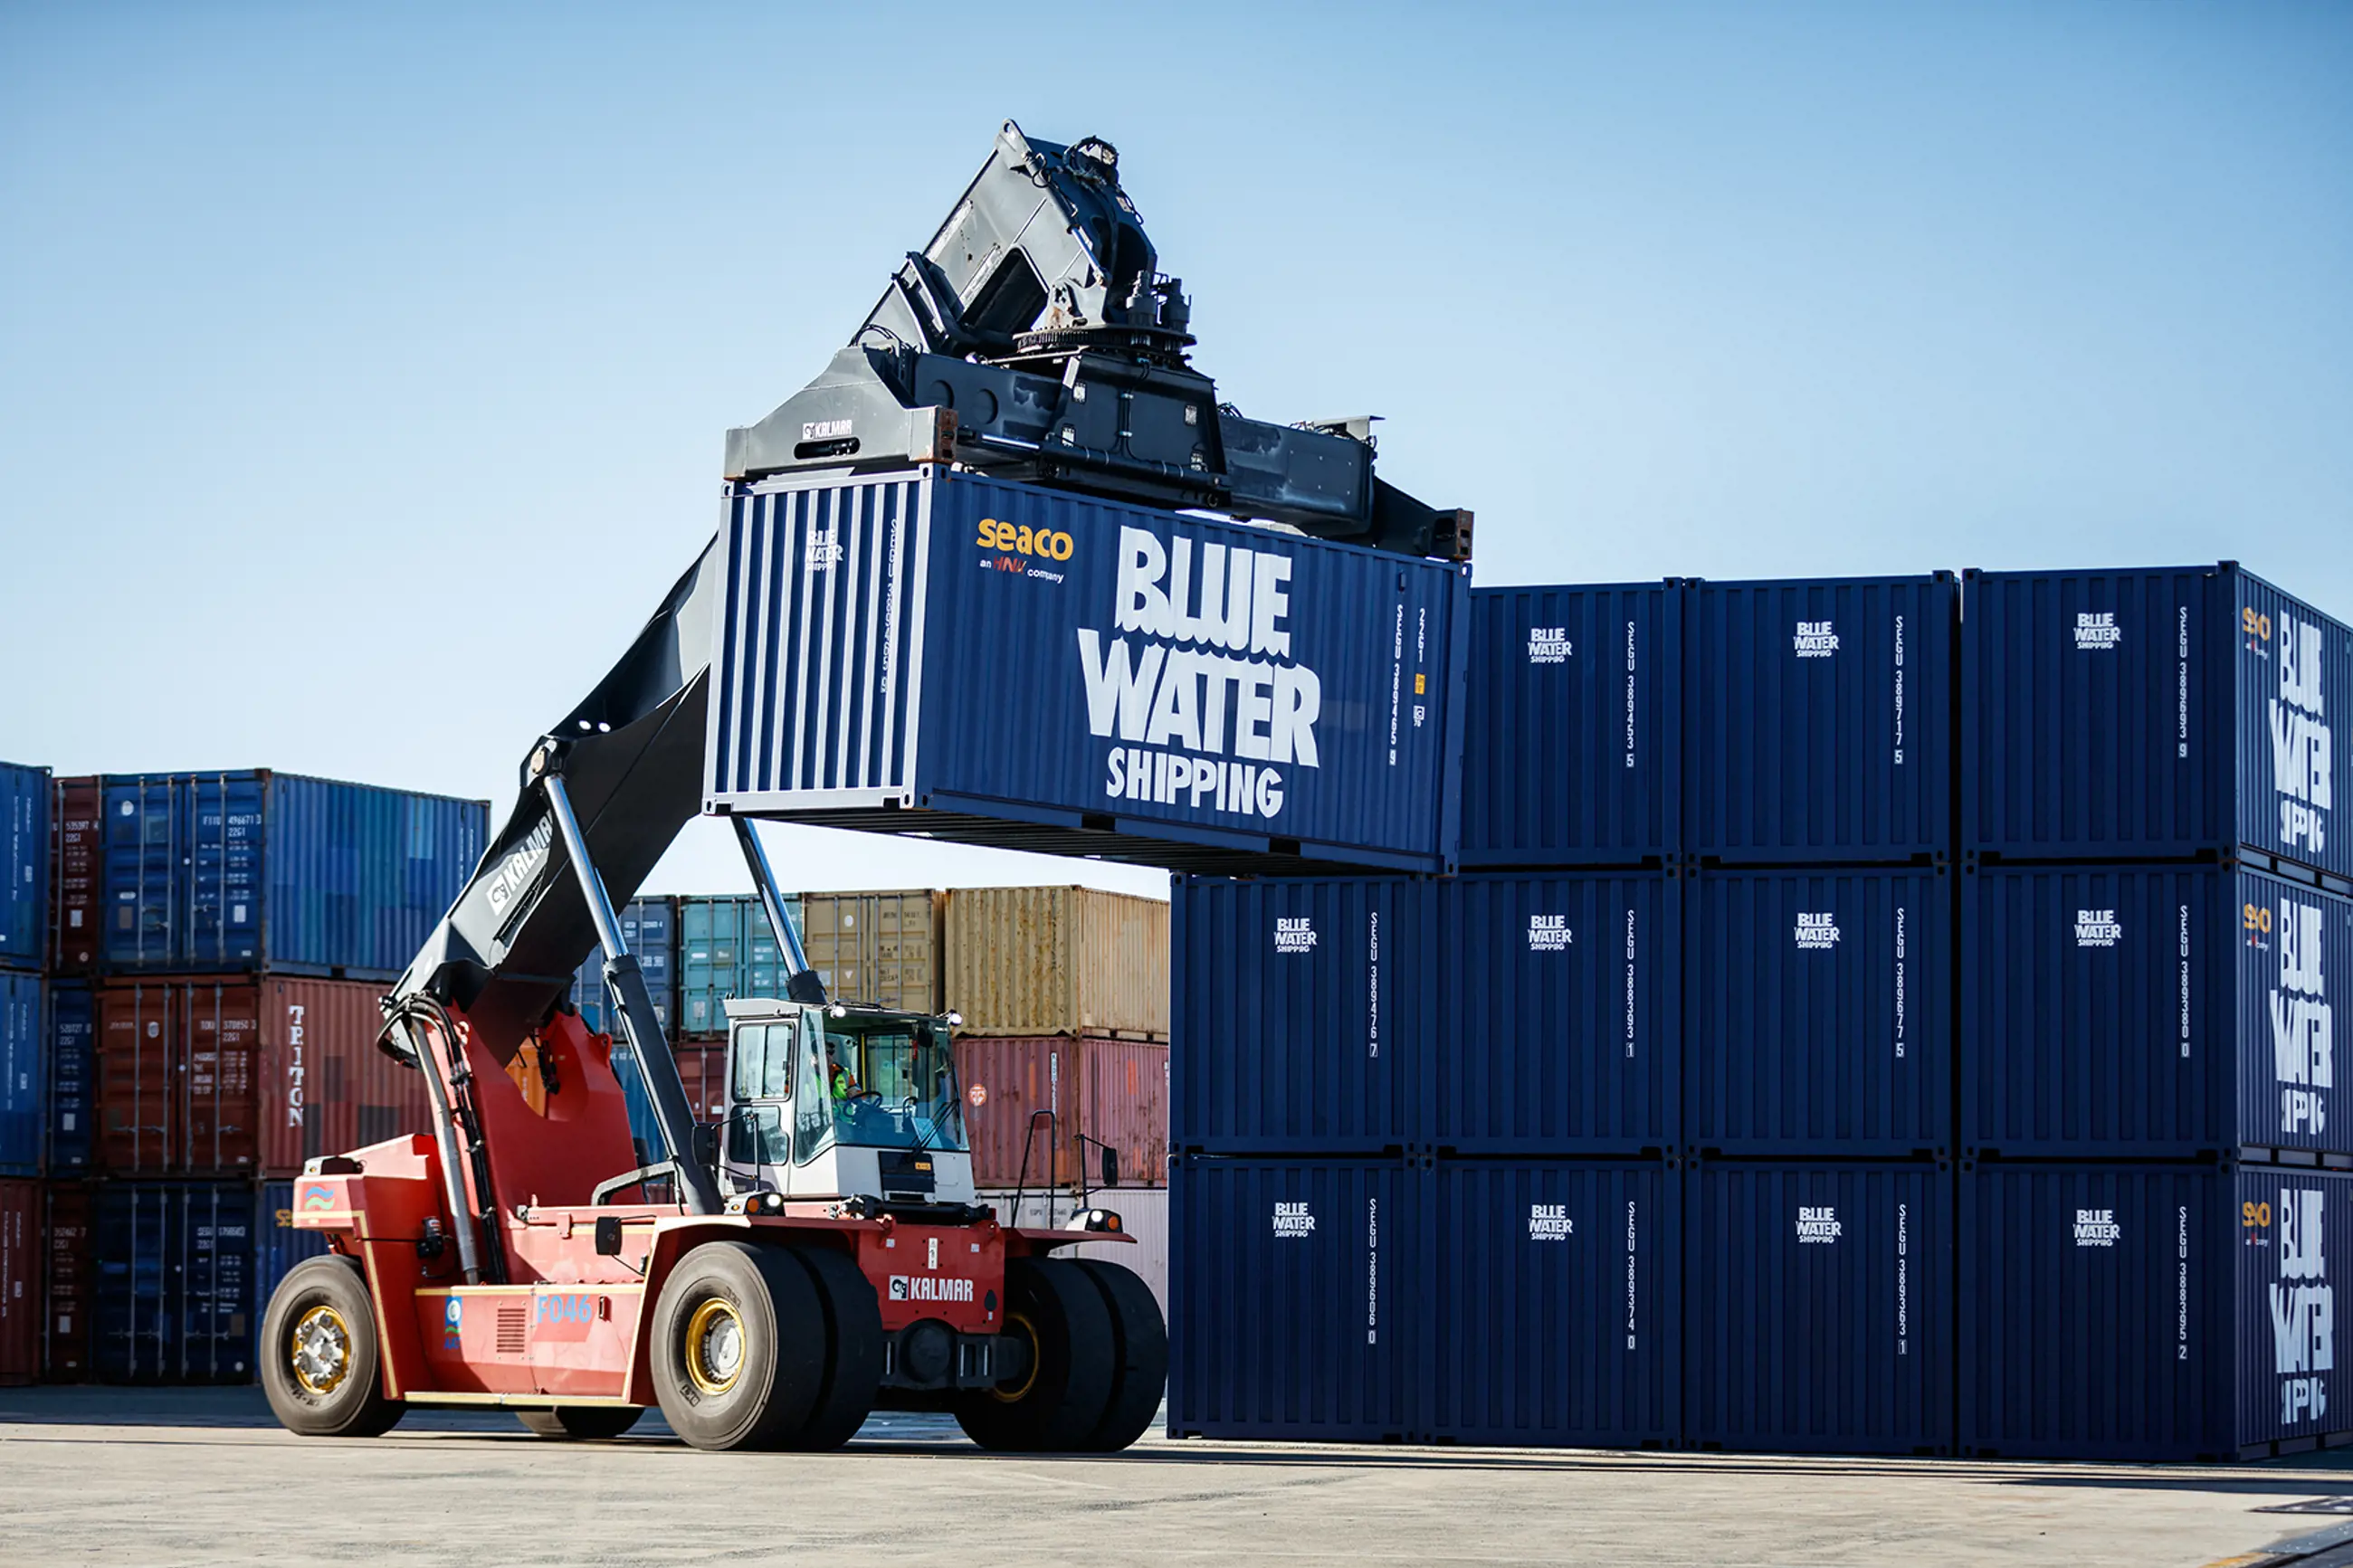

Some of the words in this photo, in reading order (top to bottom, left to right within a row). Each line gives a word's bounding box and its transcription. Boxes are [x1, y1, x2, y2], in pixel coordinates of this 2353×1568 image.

[814, 420, 853, 438] KALMAR
[976, 518, 1073, 561] seaco
[979, 558, 992, 568] an
[1026, 567, 1064, 584] company
[1114, 525, 1292, 659] BLUE
[2077, 612, 2114, 627] BLUE
[1395, 604, 1403, 660] SEGU
[1530, 627, 1566, 641] BLUE
[1796, 621, 1833, 635] BLUE
[2073, 627, 2121, 641] WATER
[2179, 606, 2187, 659] SEGU
[1527, 641, 1572, 655] WATER
[1627, 621, 1635, 671] SEGU
[1793, 635, 1839, 650] WATER
[1895, 615, 1903, 667] SEGU
[1077, 628, 1320, 768] WATER
[1106, 746, 1284, 818] SHIPPING
[503, 808, 554, 892] KALMA
[1277, 917, 1310, 931] BLUE
[1530, 915, 1566, 929] BLUE
[1797, 912, 1834, 927] BLUE
[2077, 909, 2115, 924] BLUE
[1273, 931, 1318, 945] WATER
[1527, 929, 1573, 943] WATER
[1626, 909, 1634, 960] SEGU
[1794, 927, 1840, 940] WATER
[1896, 908, 1905, 959] SEGU
[2073, 924, 2122, 938] WATER
[2180, 905, 2189, 957] SEGU
[289, 1005, 305, 1127] TRITON
[1274, 1202, 1309, 1216] BLUE
[1531, 1204, 1567, 1219] BLUE
[1798, 1206, 1835, 1221] BLUE
[2076, 1209, 2113, 1223] BLUE
[1272, 1216, 1316, 1230] WATER
[1529, 1219, 1573, 1232] WATER
[1627, 1201, 1635, 1252] SEGU
[1795, 1221, 1842, 1235] WATER
[1898, 1203, 1907, 1256] SEGU
[2072, 1223, 2120, 1238] WATER
[2179, 1205, 2187, 1259] SEGU
[910, 1278, 974, 1301] KALMAR
[538, 1295, 592, 1323] F046
